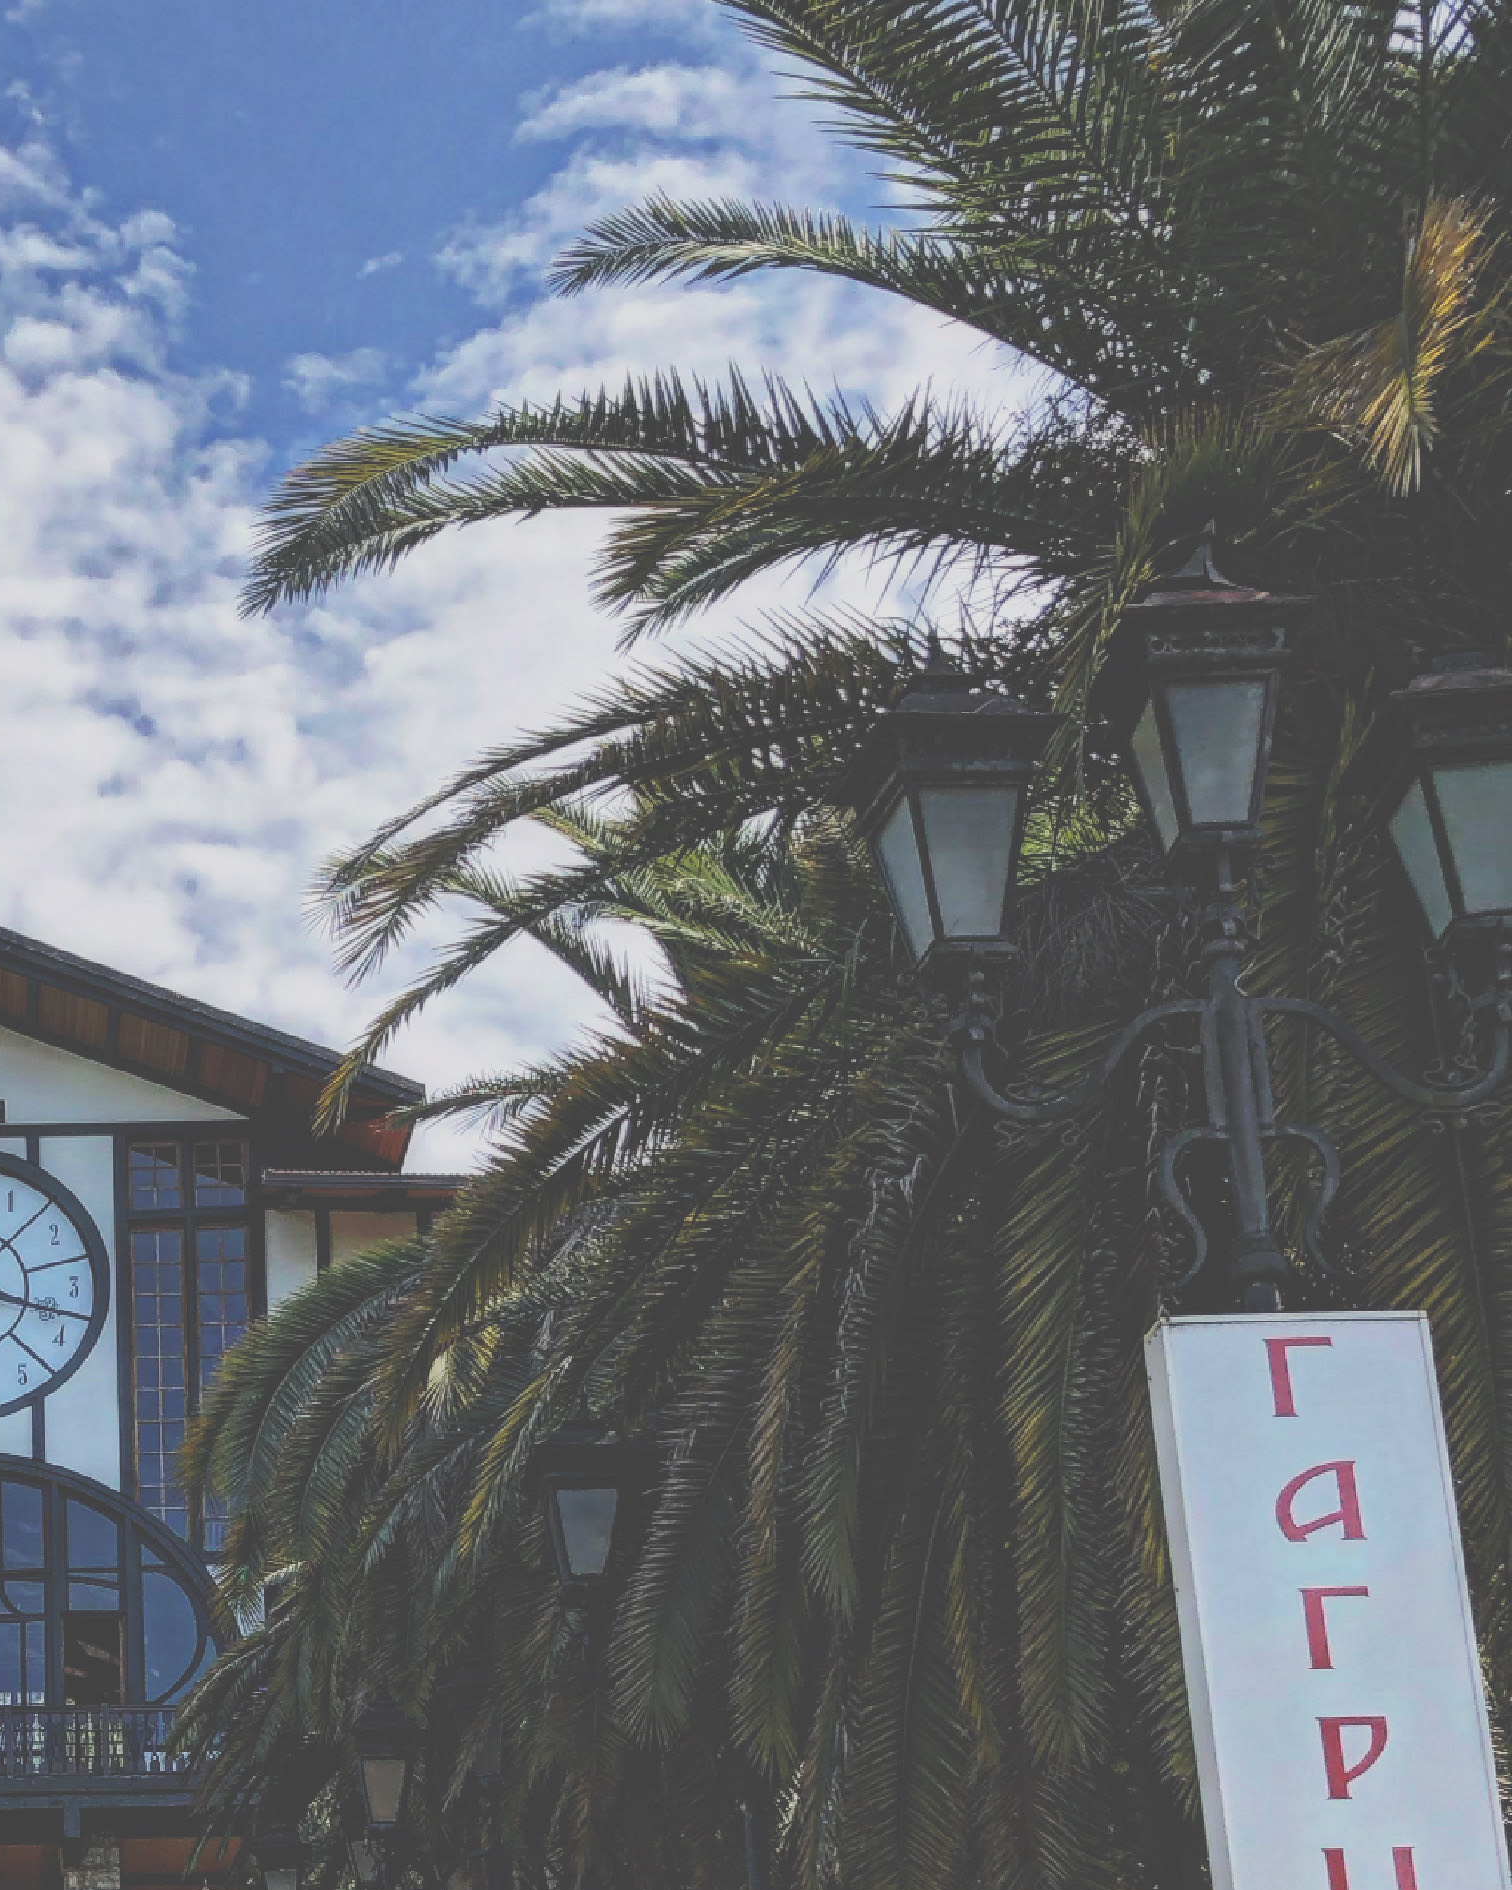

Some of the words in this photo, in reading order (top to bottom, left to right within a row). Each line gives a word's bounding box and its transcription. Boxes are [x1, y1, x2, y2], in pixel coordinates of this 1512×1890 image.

[6, 1189, 14, 1213] 1
[48, 1223, 61, 1246] 2
[68, 1275, 79, 1299] 3
[51, 1323, 65, 1347] 4
[16, 1362, 28, 1386] 5
